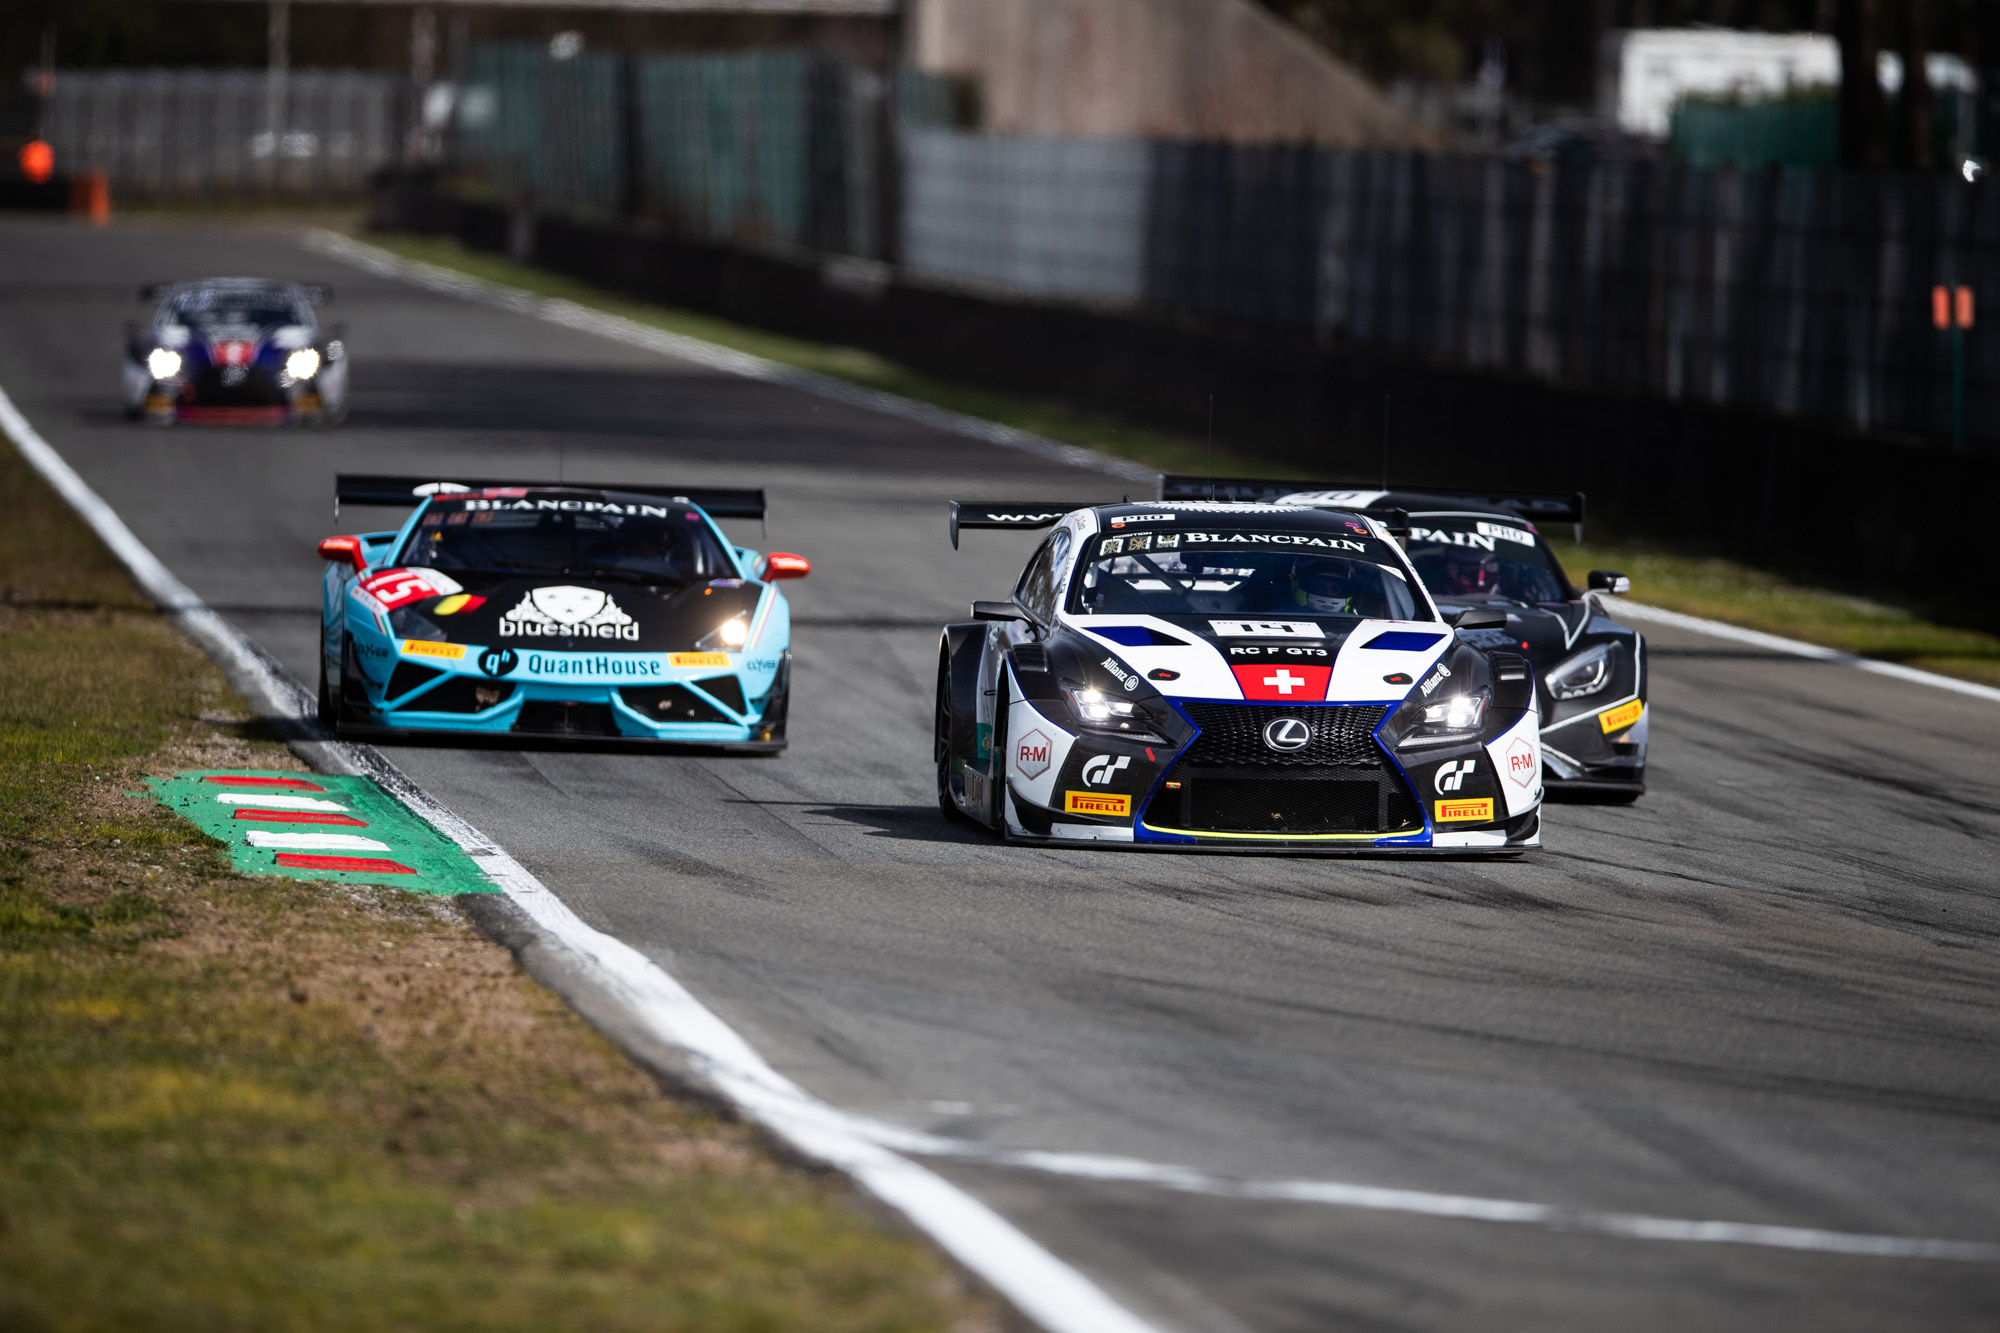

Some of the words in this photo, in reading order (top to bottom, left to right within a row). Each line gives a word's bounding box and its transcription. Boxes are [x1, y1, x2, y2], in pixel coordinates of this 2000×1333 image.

[465, 499, 667, 518] BLANCPAIN
[1381, 521, 1497, 552] PAIN
[1488, 524, 1524, 541] PRO
[1184, 533, 1366, 552] BLANCPAIN
[499, 616, 639, 641] blueshield
[1229, 647, 1261, 655] RC
[1266, 647, 1280, 655] F
[1286, 648, 1328, 657] GT3
[528, 654, 661, 676] QuantHouse
[1100, 657, 1129, 683] Allianz
[1420, 671, 1444, 698] Allianz
[1020, 746, 1047, 762] R-M
[1511, 753, 1533, 772] R-M
[1072, 795, 1126, 813] PIRELLI
[1441, 802, 1489, 818] PIRELLI
